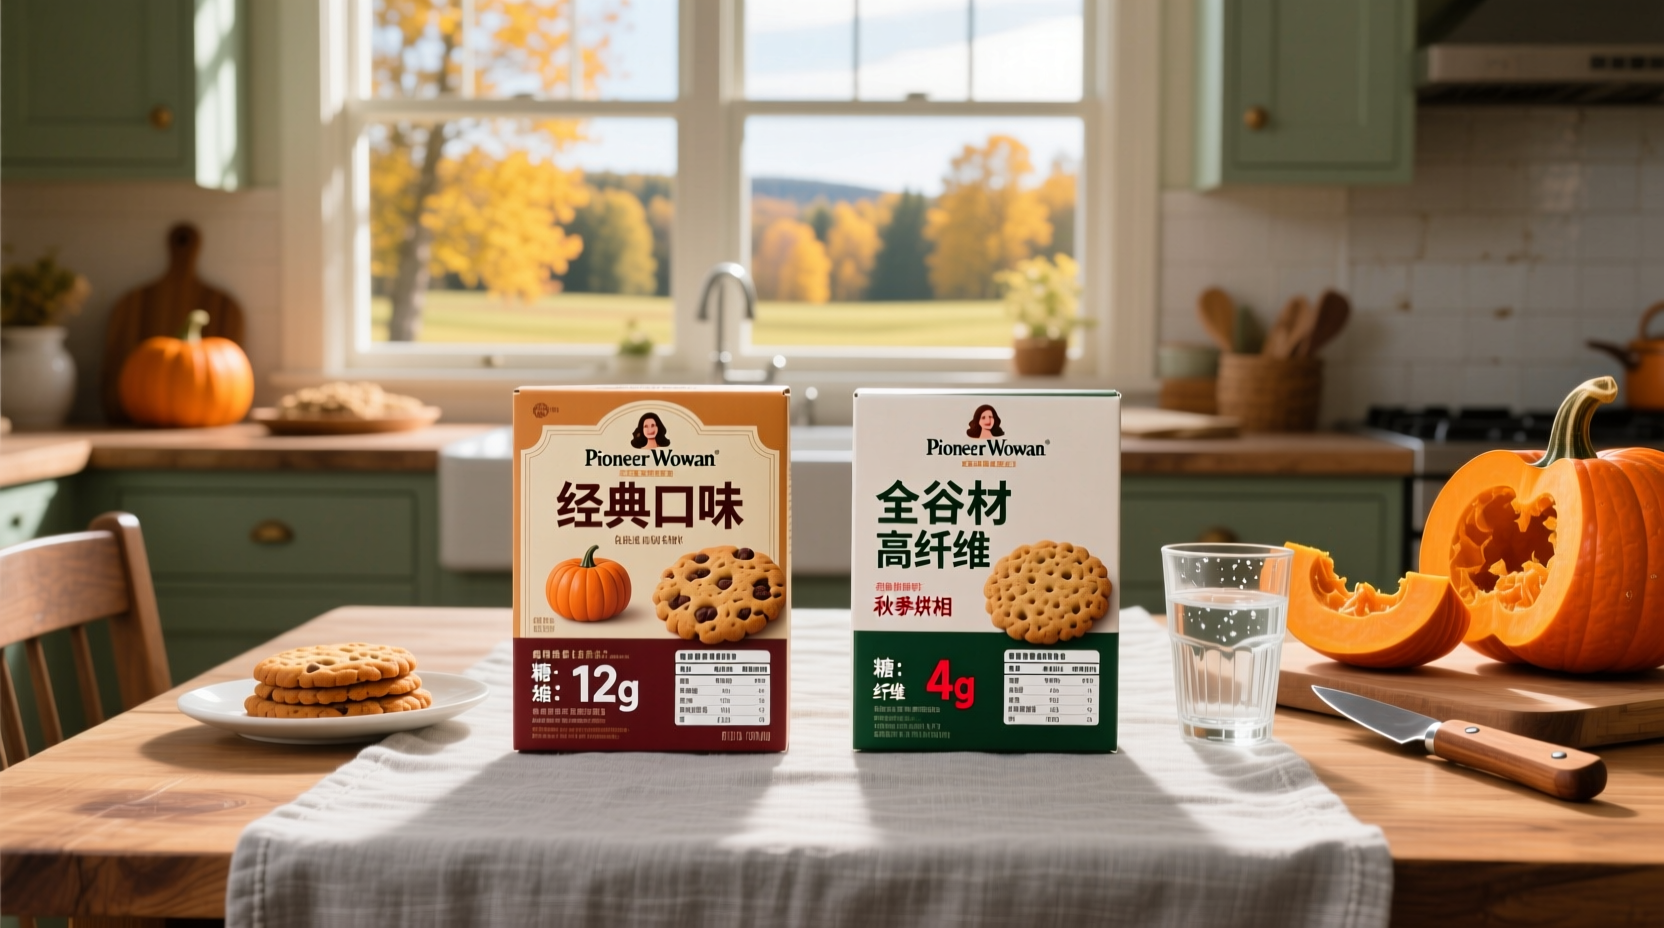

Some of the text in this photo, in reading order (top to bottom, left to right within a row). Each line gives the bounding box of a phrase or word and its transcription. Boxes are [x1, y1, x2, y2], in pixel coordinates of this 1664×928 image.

[585, 449, 716, 467] Pioneer Wowan
[926, 439, 1046, 457] Pioneer Wowan
[556, 481, 744, 530] 经典口味
[876, 479, 1012, 526] 全谷材
[876, 529, 991, 570] 高纤维
[572, 664, 639, 713] 12g
[926, 658, 975, 710] 4g
